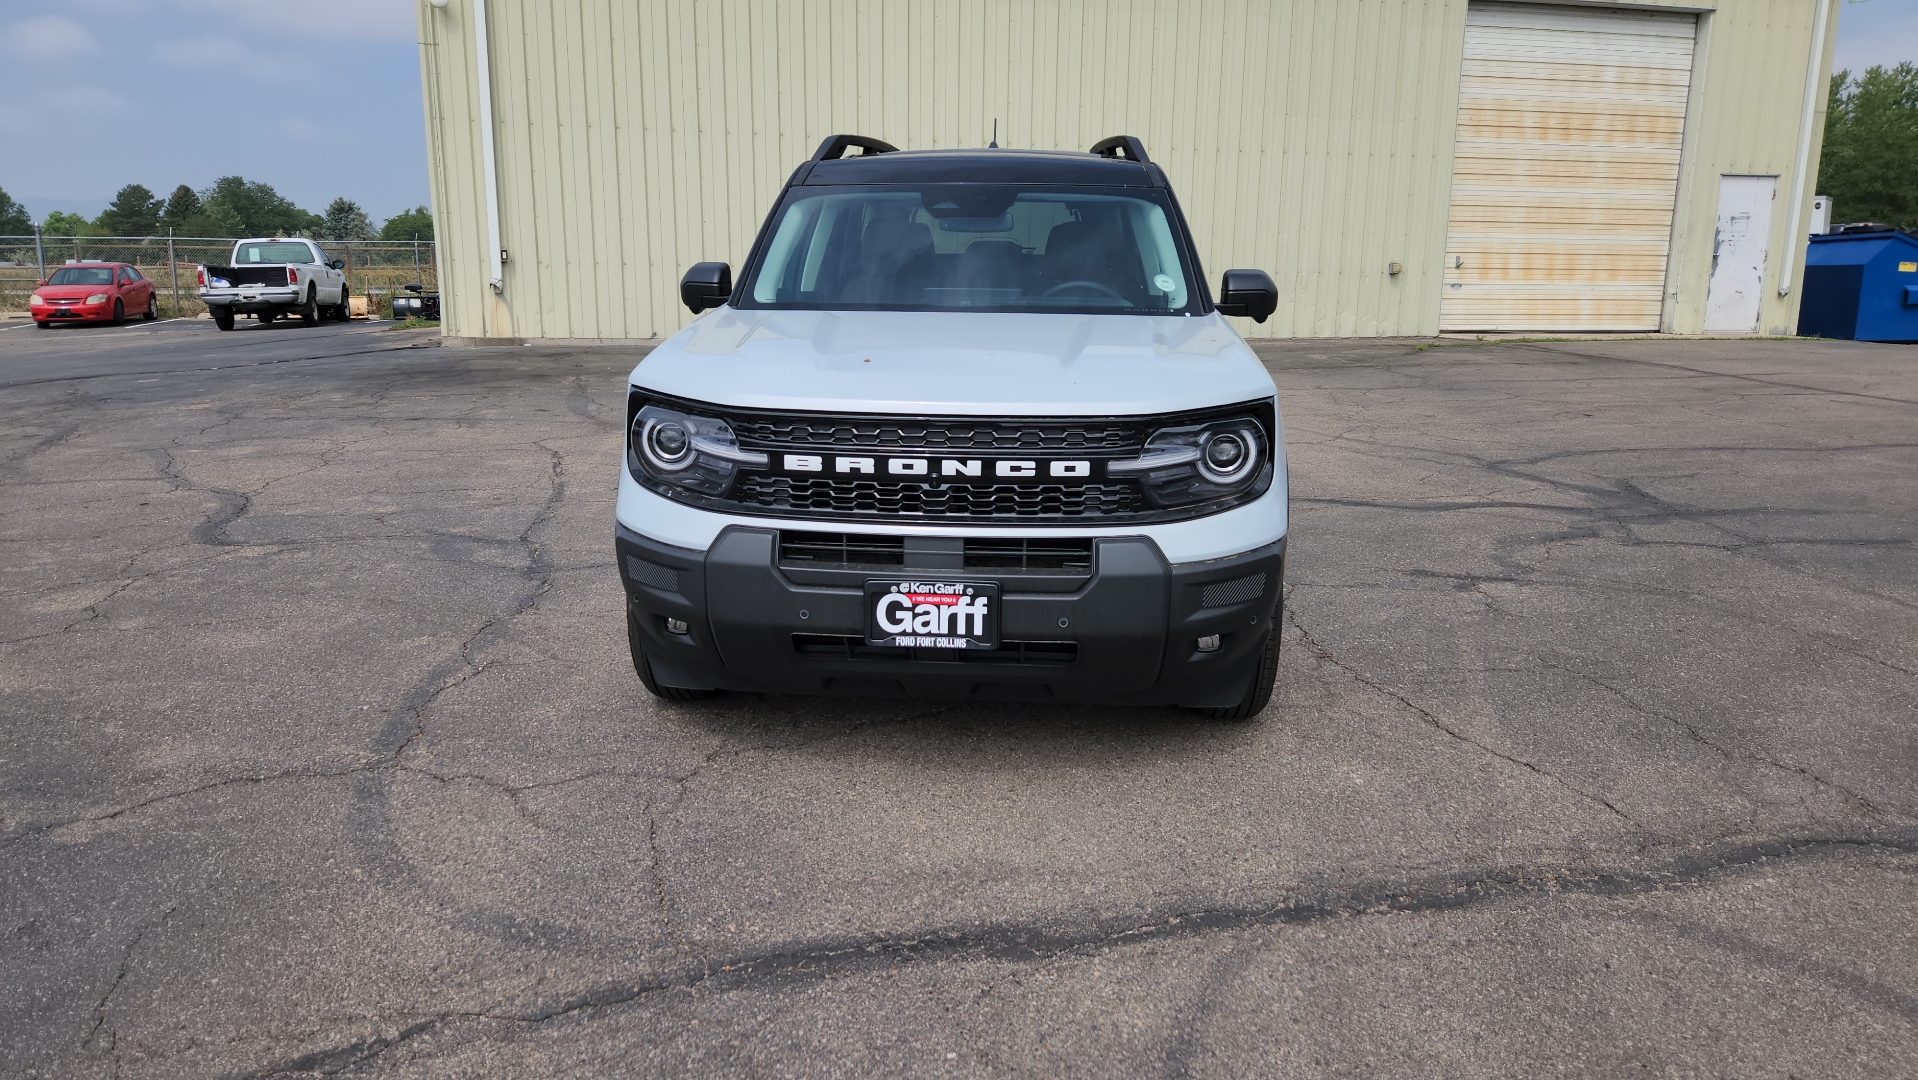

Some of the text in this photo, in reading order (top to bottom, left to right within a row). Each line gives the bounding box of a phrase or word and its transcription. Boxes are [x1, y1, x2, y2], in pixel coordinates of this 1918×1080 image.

[783, 454, 1091, 477] BRONCO
[910, 582, 964, 595] Ken Garff
[876, 592, 988, 636] Garff
[895, 636, 967, 649] FORD FORT COLLINS
